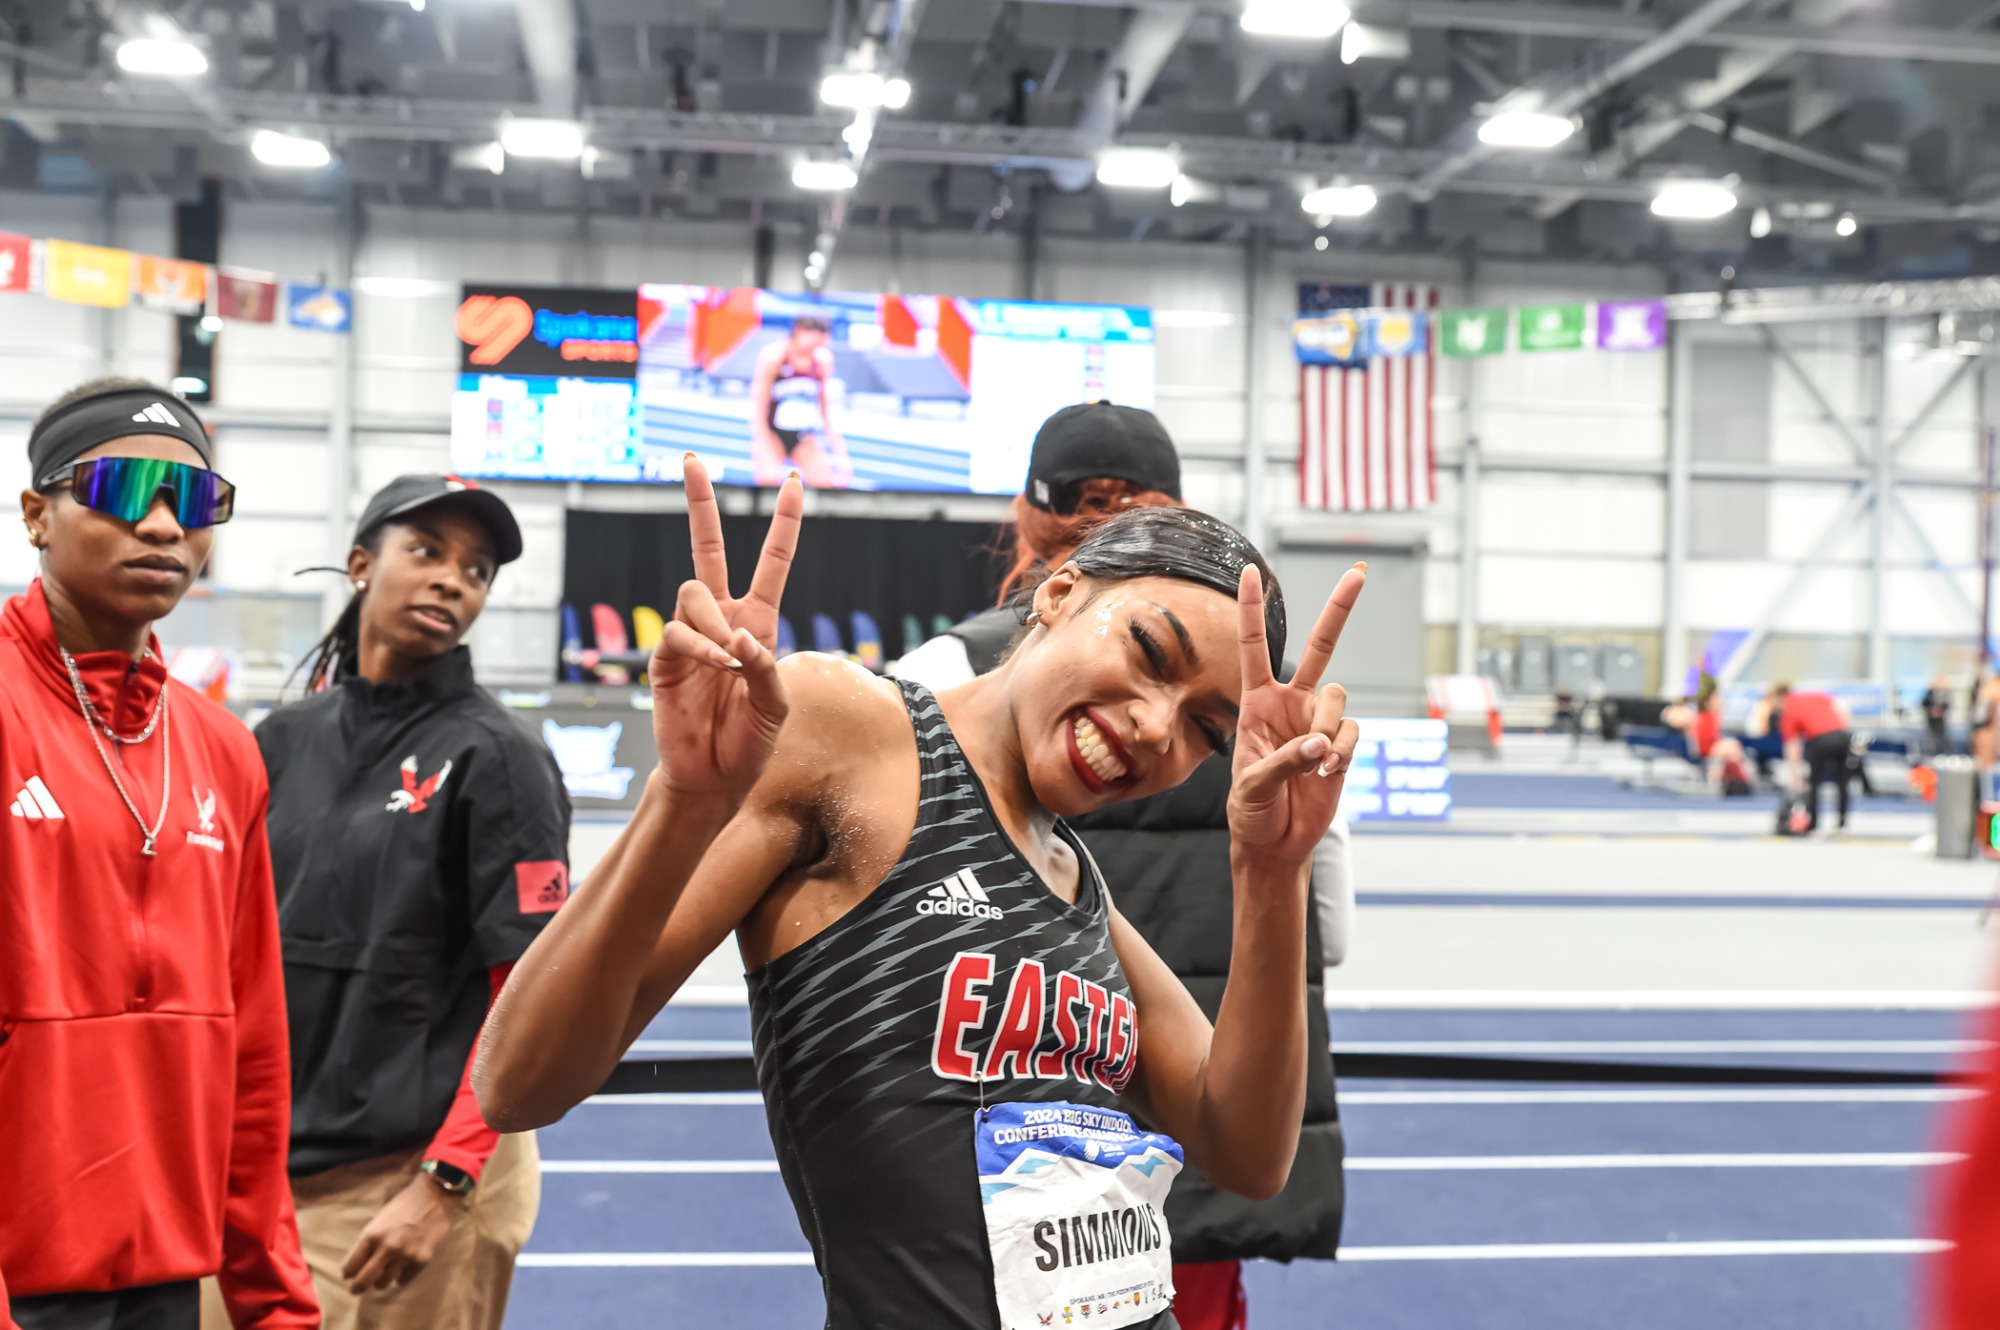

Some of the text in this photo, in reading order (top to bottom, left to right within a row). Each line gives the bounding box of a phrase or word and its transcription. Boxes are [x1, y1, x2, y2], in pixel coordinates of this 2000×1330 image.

[916, 896, 1004, 920] adidas
[1023, 1109, 1063, 1125] 2024
[1061, 1109, 1082, 1126] BIG
[1082, 1111, 1102, 1128] SKY
[1033, 1202, 1161, 1272] SIMMONS
